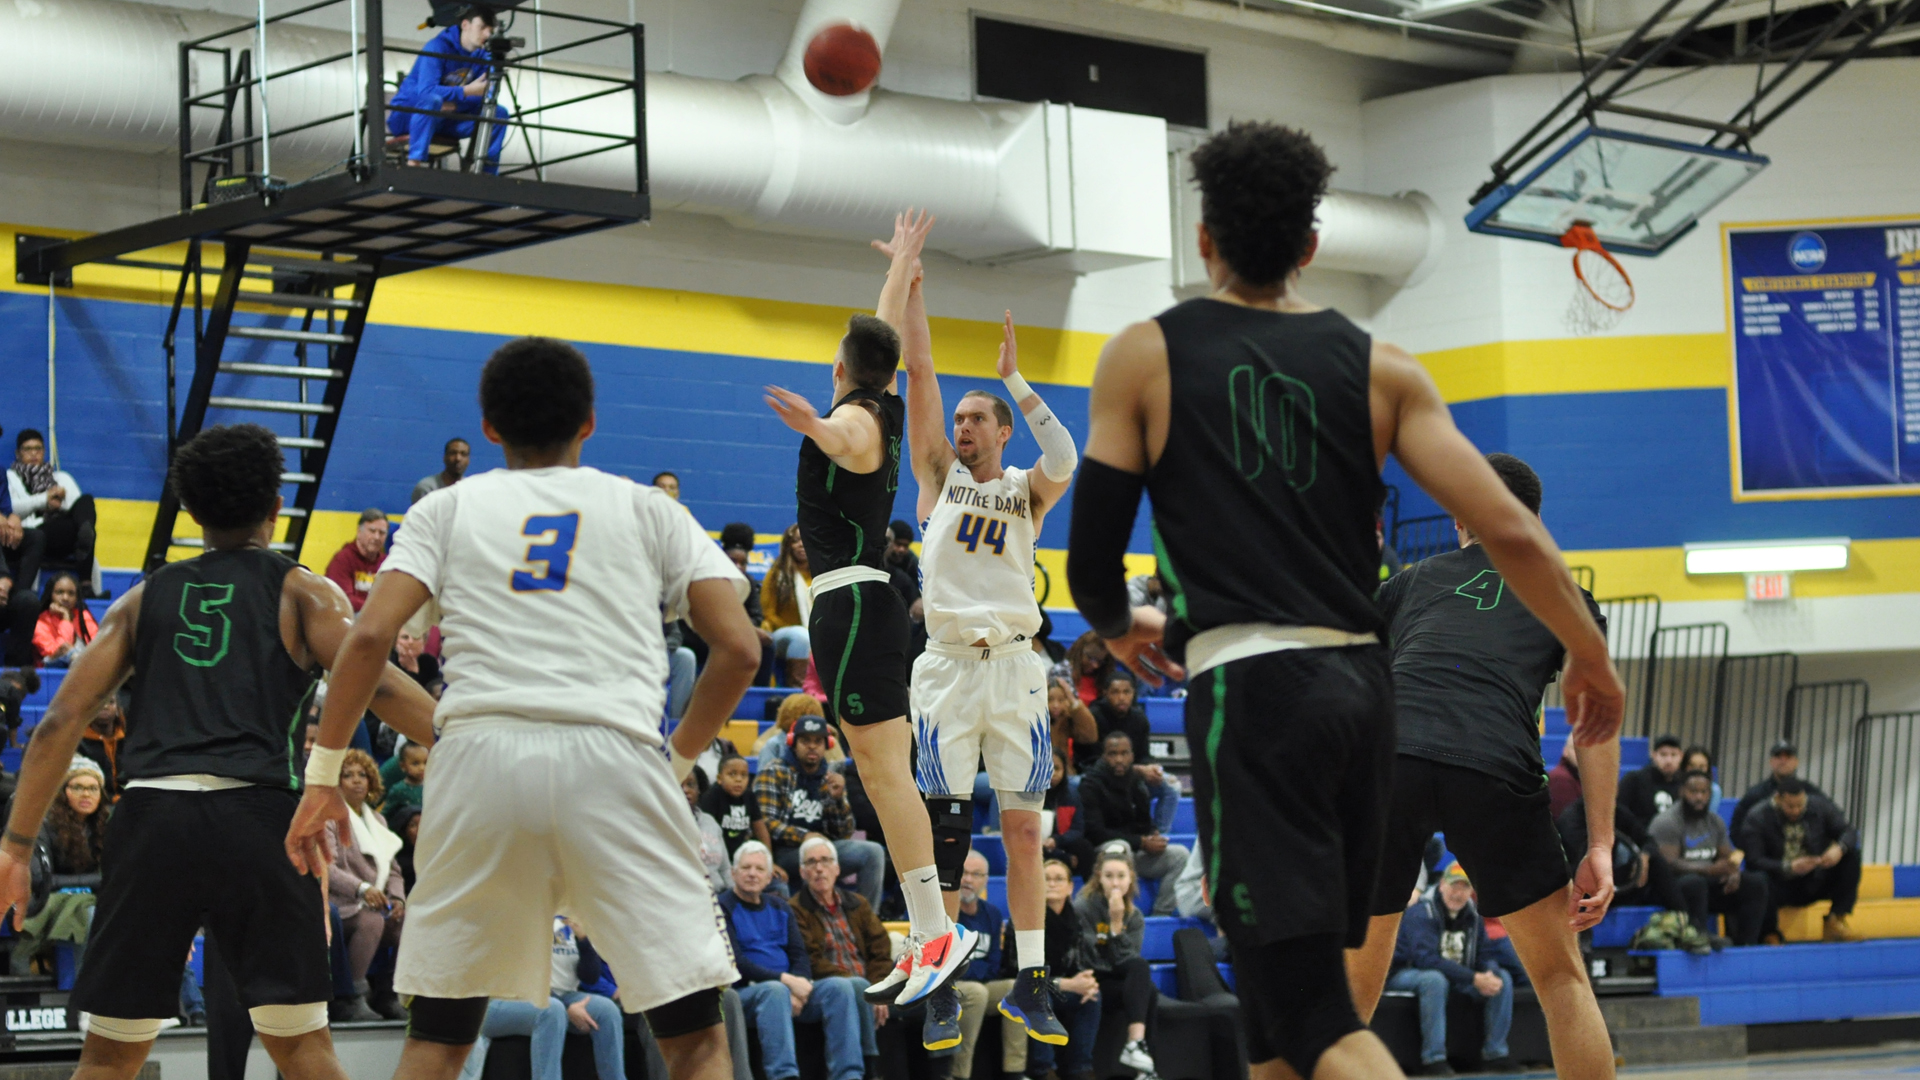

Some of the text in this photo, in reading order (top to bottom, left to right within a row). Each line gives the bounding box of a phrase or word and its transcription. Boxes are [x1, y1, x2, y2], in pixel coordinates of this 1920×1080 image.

[1228, 364, 1318, 493] 10
[945, 485, 1027, 519] NOTRE DAME
[509, 510, 581, 593] 3
[955, 511, 1008, 556] 44
[1454, 569, 1504, 611] 4
[1756, 574, 1783, 600] EXIT
[173, 582, 235, 667] 5
[6, 1007, 67, 1032] LLEGE
